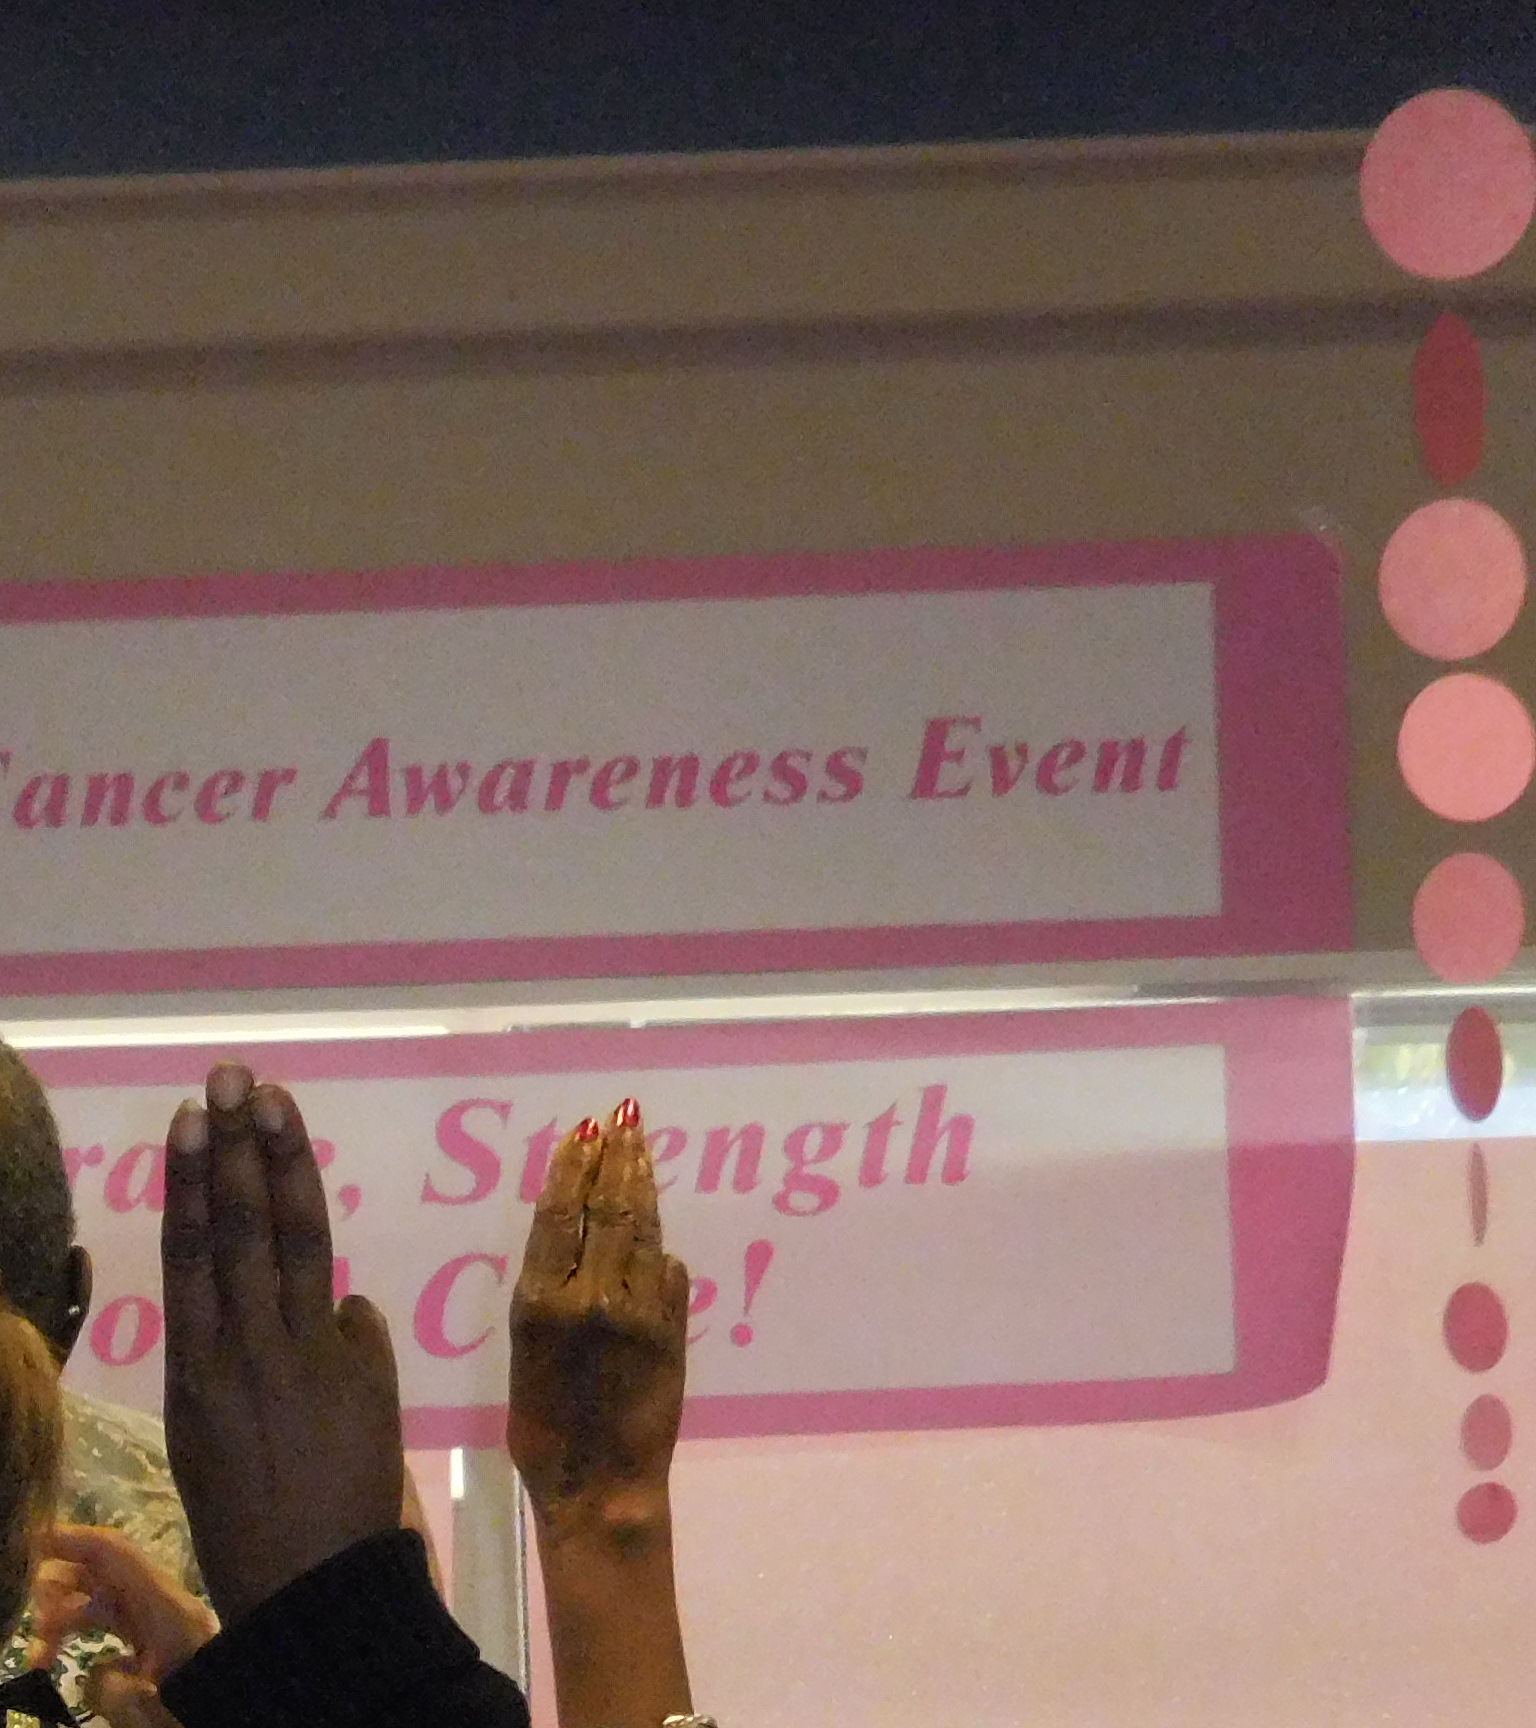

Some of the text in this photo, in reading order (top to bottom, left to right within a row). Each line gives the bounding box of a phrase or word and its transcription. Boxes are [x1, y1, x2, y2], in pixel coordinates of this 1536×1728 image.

[318, 736, 871, 822] Awareness
[909, 713, 1190, 801] Event
[420, 1084, 976, 1217] Stength
